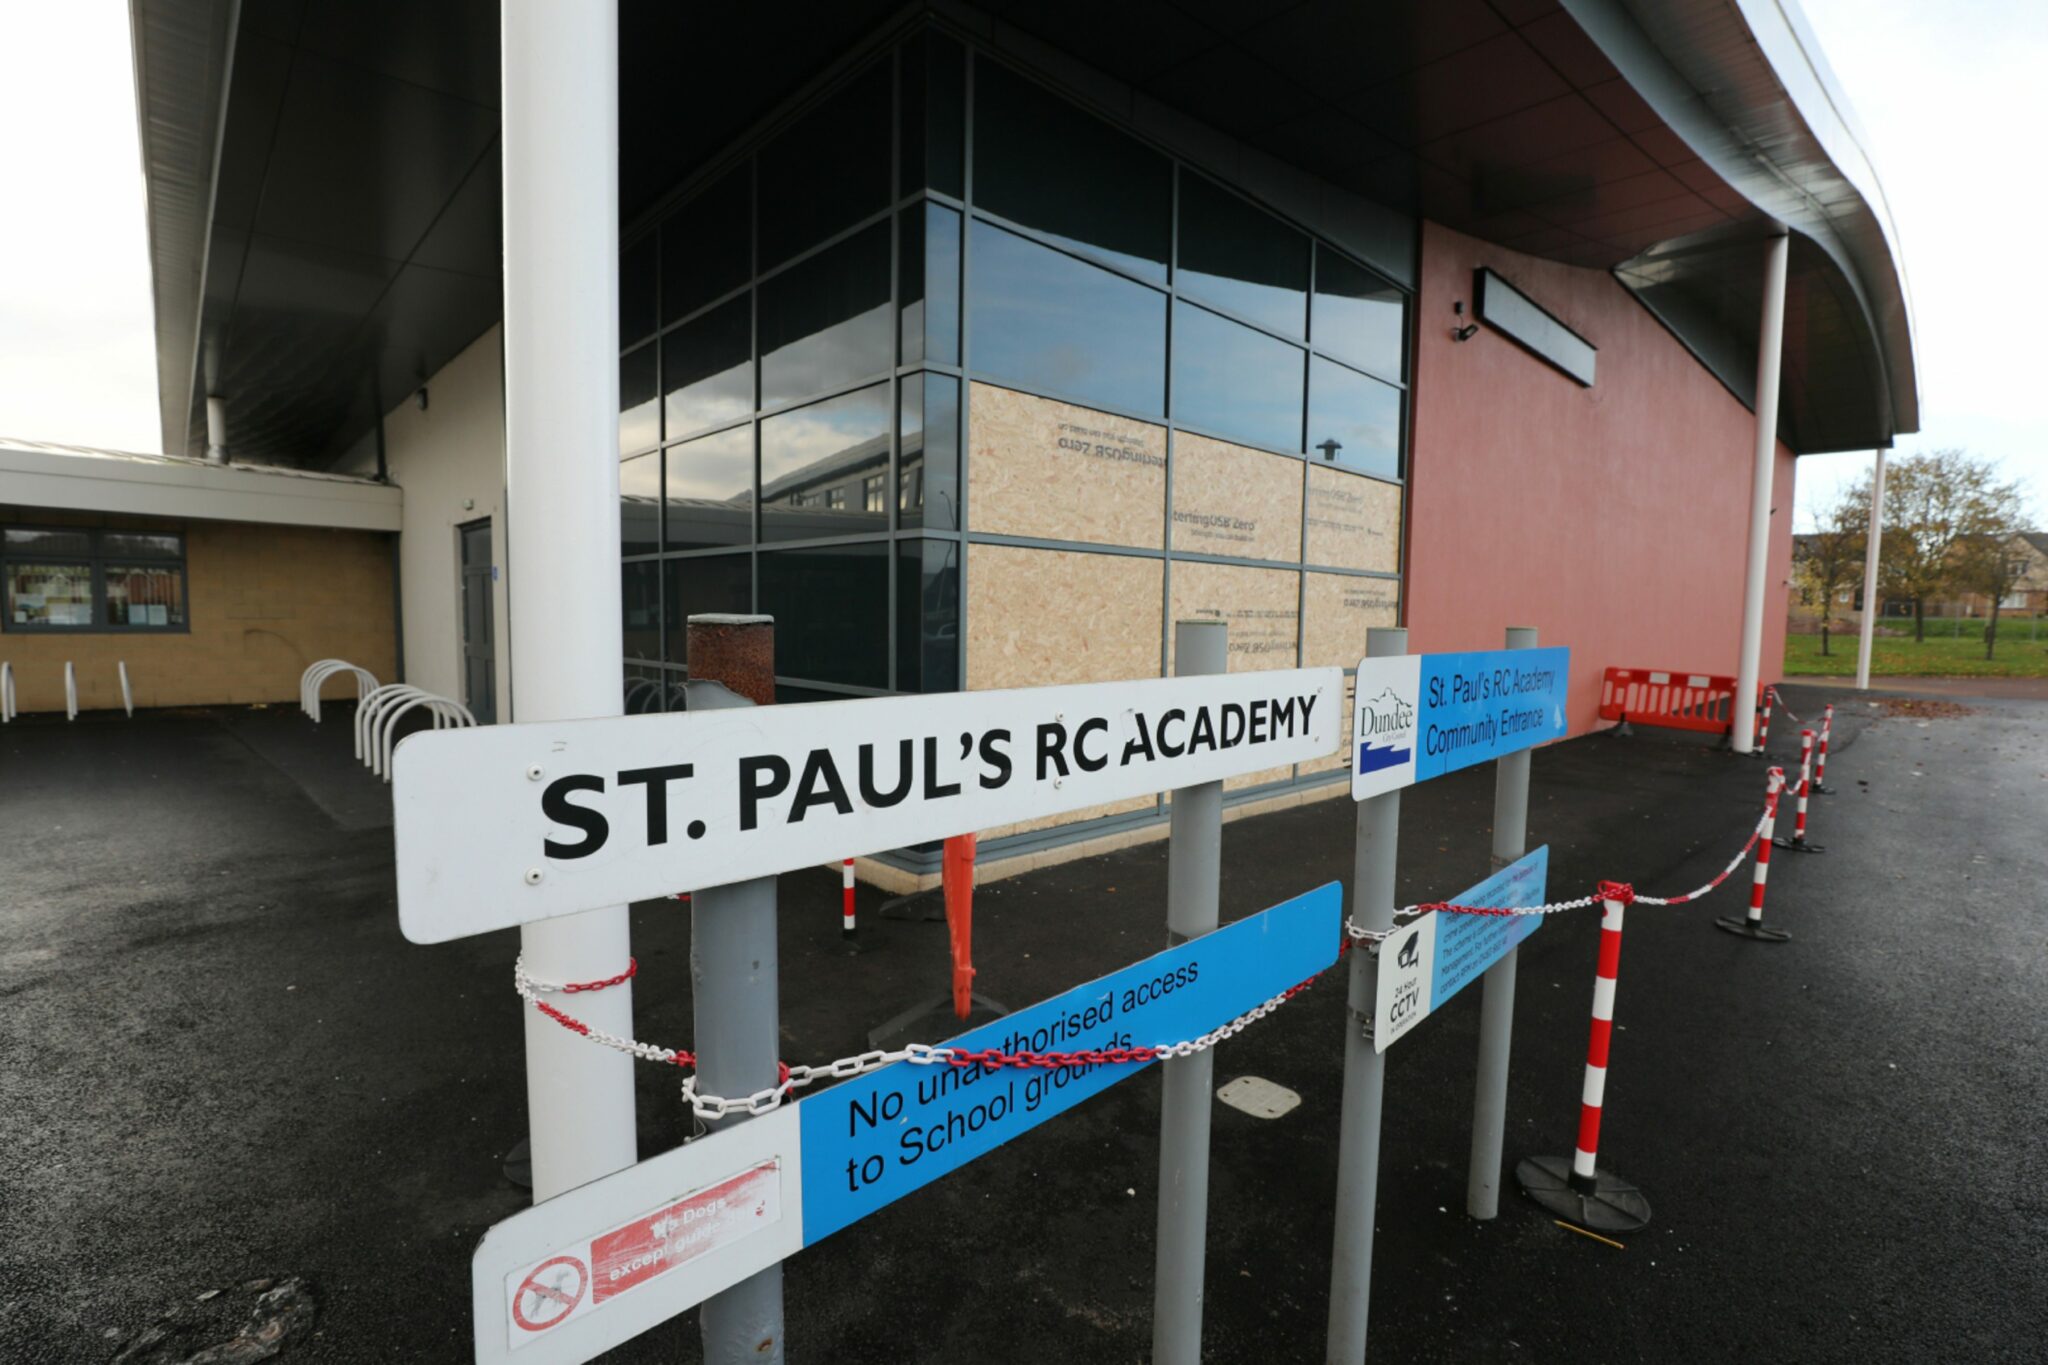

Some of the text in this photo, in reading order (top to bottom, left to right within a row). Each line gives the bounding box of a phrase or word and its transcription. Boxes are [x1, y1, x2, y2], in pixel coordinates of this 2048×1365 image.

[1429, 666, 1555, 708] St. Paul's RC Academy
[1361, 704, 1413, 737] Dundee
[1427, 708, 1544, 757] Community Entrance
[541, 694, 1317, 860] ST. PAUL'S RC ACADEMY
[1390, 988, 1420, 1023] CCTV
[850, 1090, 904, 1138] No
[1121, 958, 1199, 1011] access
[847, 1153, 885, 1192] to
[899, 1082, 1014, 1166] School
[682, 1198, 726, 1225] Dogs
